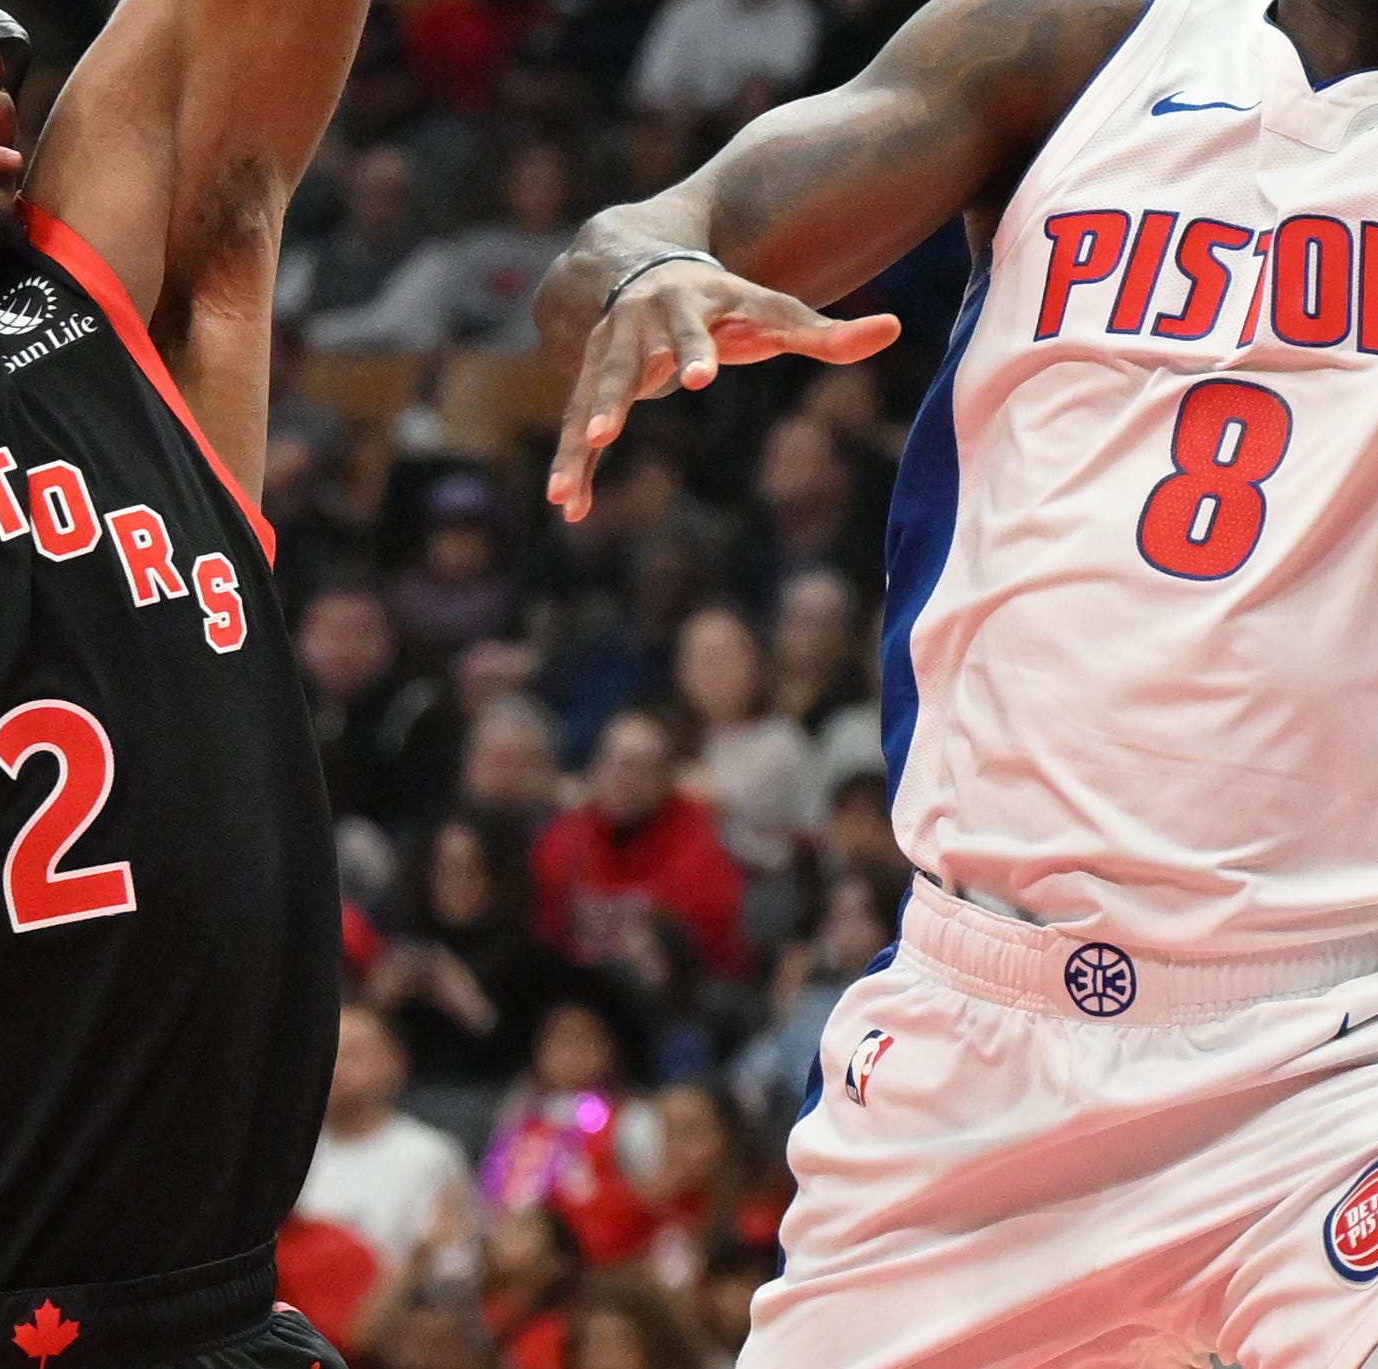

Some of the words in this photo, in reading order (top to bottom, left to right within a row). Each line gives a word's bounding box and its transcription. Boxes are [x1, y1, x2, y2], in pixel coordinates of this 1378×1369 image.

[1, 341, 50, 375] Sun
[44, 313, 99, 349] Life
[1136, 377, 1293, 581] 8
